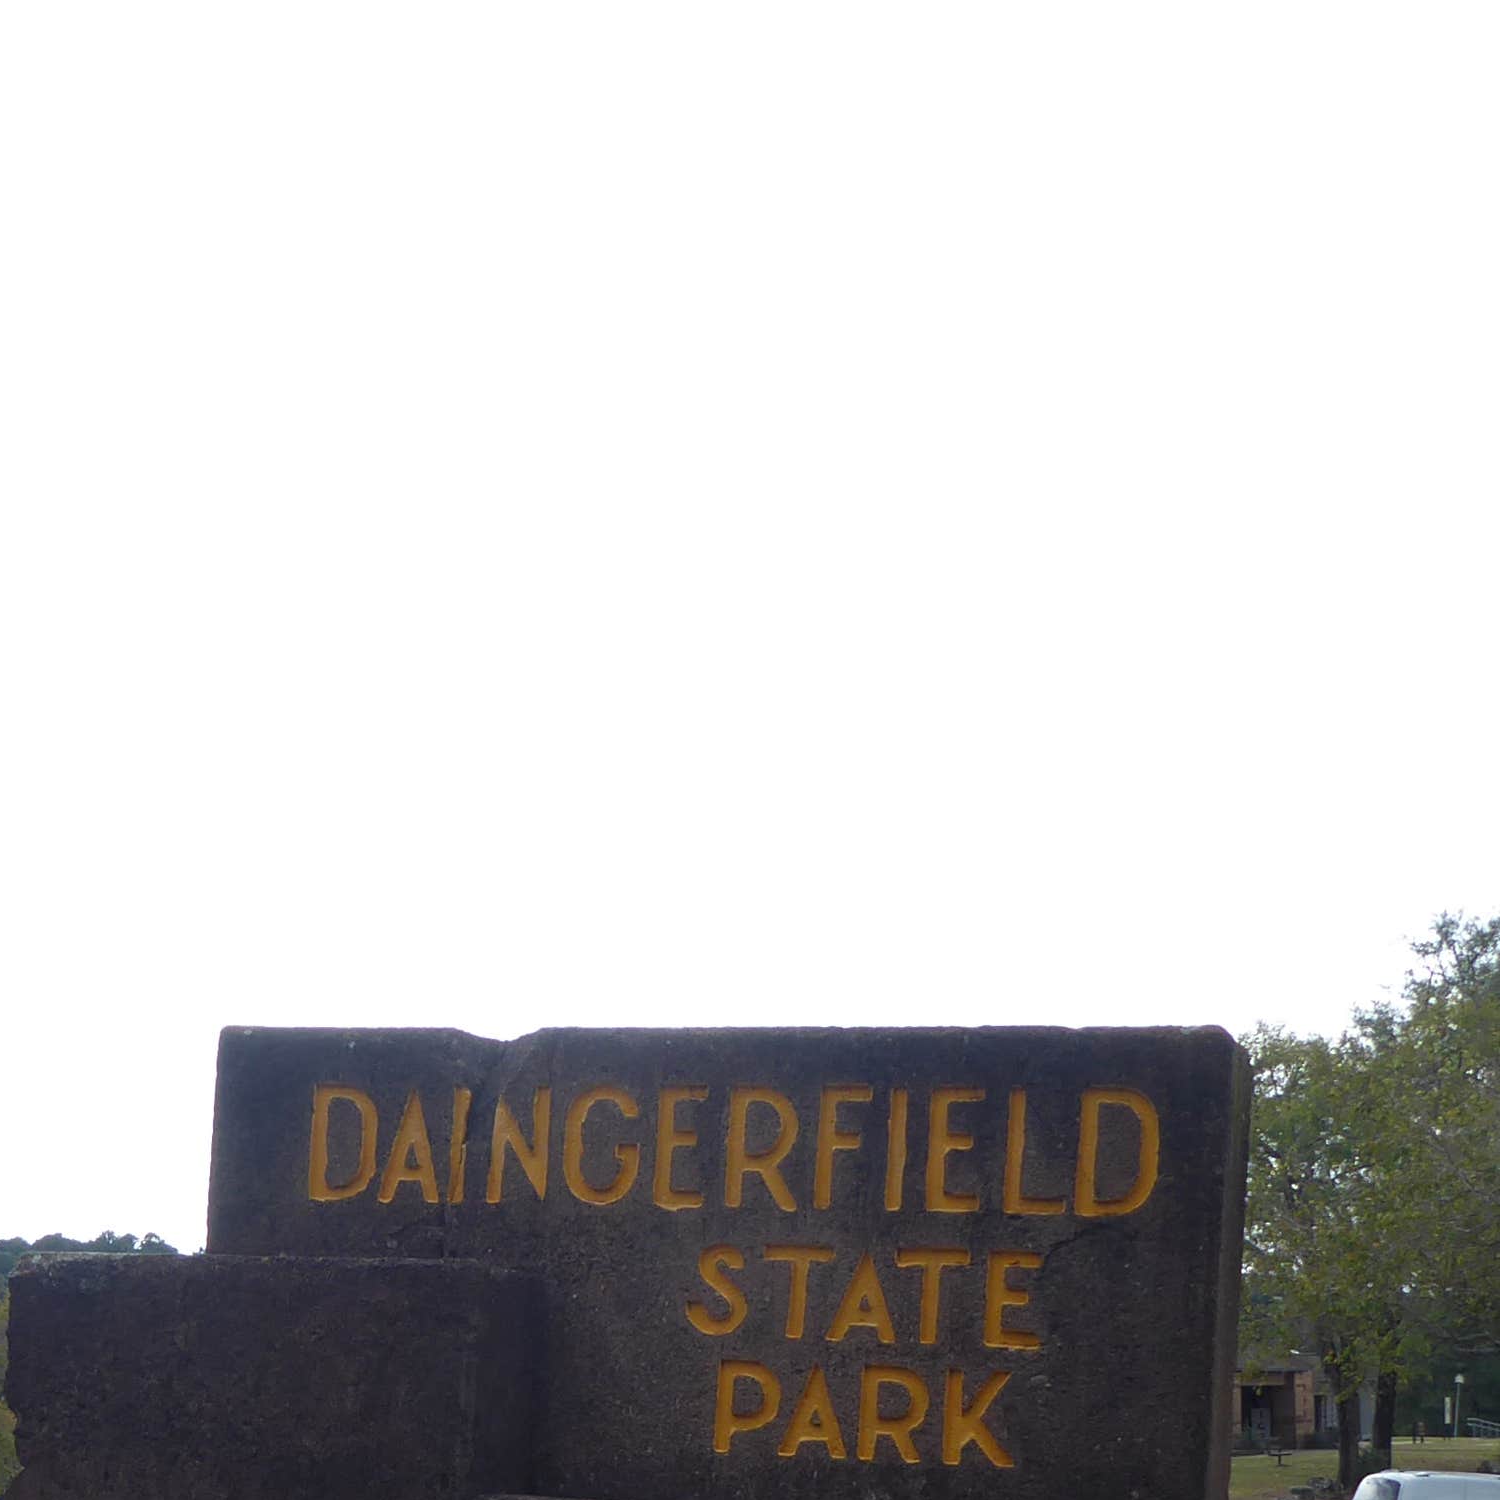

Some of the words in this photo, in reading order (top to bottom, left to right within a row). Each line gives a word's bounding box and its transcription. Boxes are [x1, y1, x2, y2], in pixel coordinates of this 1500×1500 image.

[307, 1085, 1161, 1218] DAINGERFIELD
[686, 1244, 1045, 1350] STATE
[712, 1359, 1014, 1468] PARK
